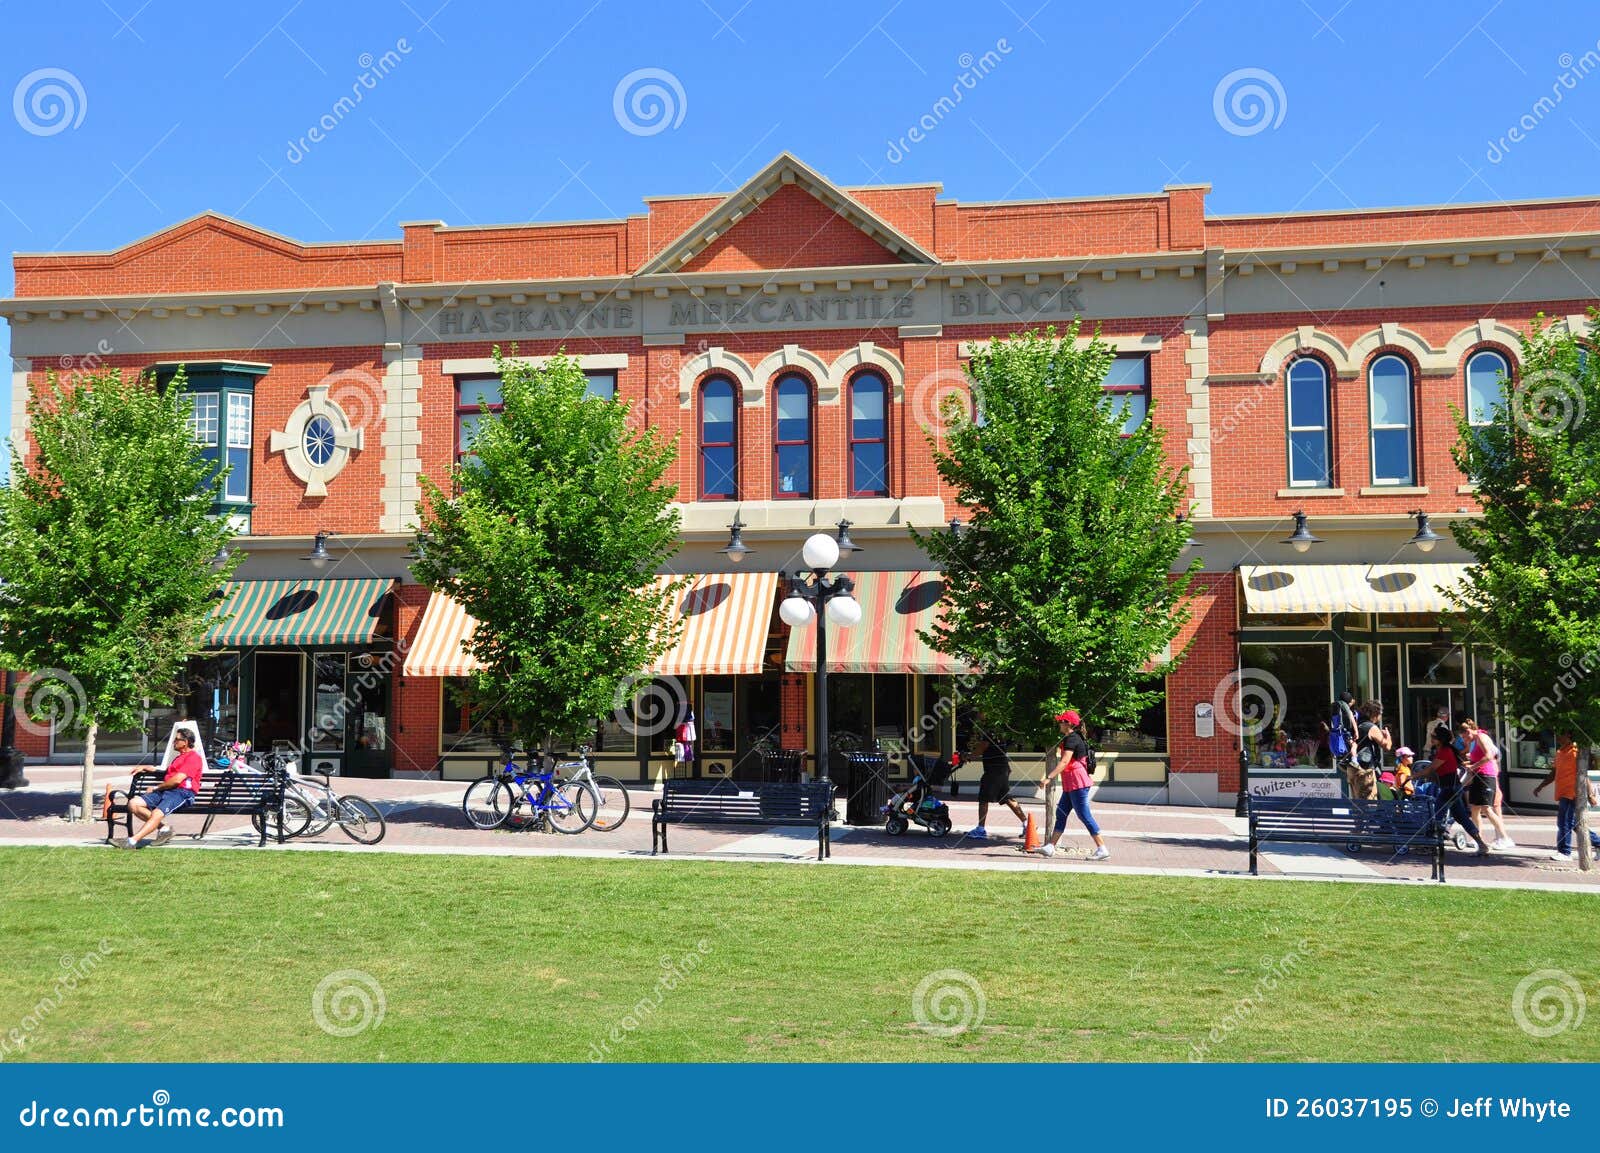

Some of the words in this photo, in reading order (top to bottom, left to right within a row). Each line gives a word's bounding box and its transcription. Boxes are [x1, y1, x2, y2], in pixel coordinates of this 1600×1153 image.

[438, 303, 634, 335] HASKAYNE
[669, 294, 915, 326] MERCANTILE
[951, 286, 1087, 317] BLOCK
[1253, 779, 1306, 797] Switzer's
